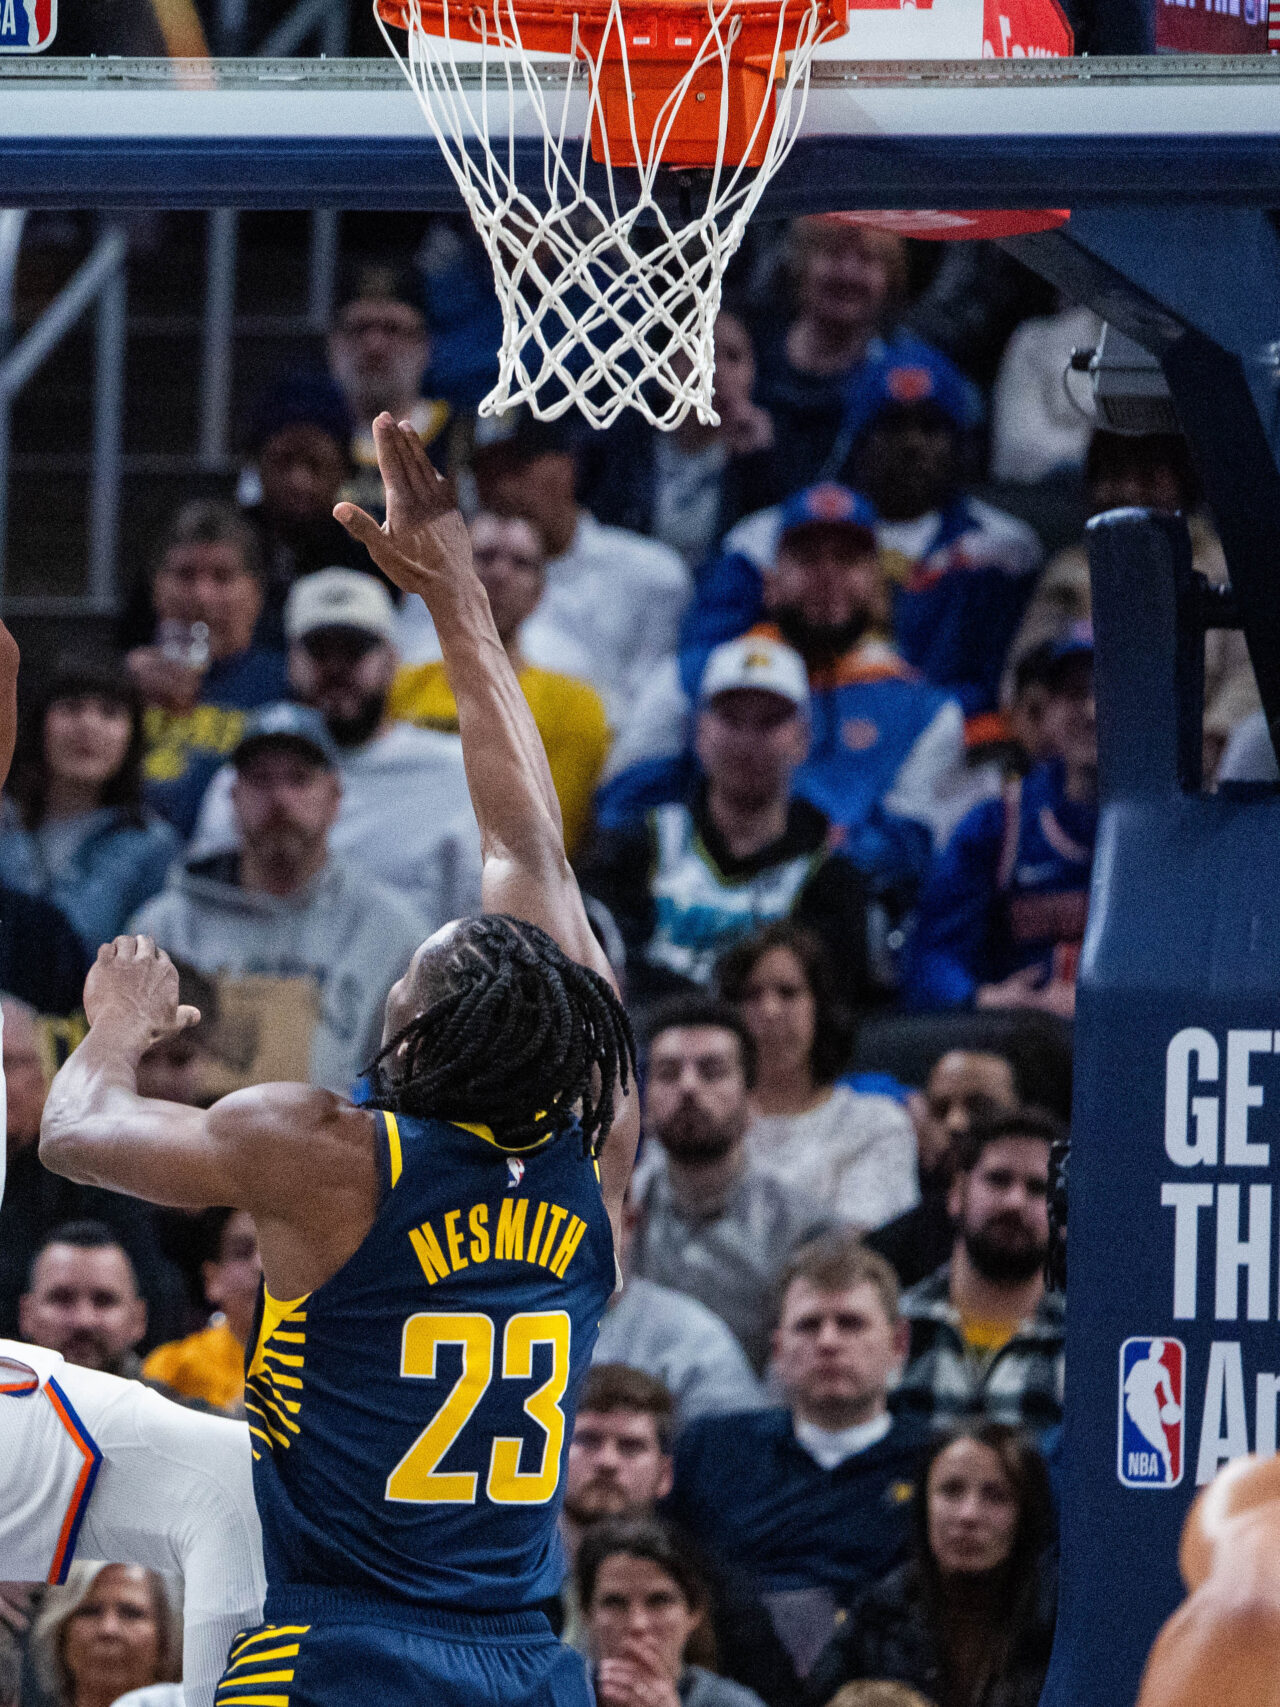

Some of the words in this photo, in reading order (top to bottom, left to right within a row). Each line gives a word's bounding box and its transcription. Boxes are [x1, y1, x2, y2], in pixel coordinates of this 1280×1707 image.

[1165, 1027, 1280, 1167] GE
[408, 1198, 588, 1286] NESMITH
[1161, 1183, 1280, 1322] TH
[384, 1310, 572, 1504] 23
[1128, 1452, 1159, 1477] NBA
